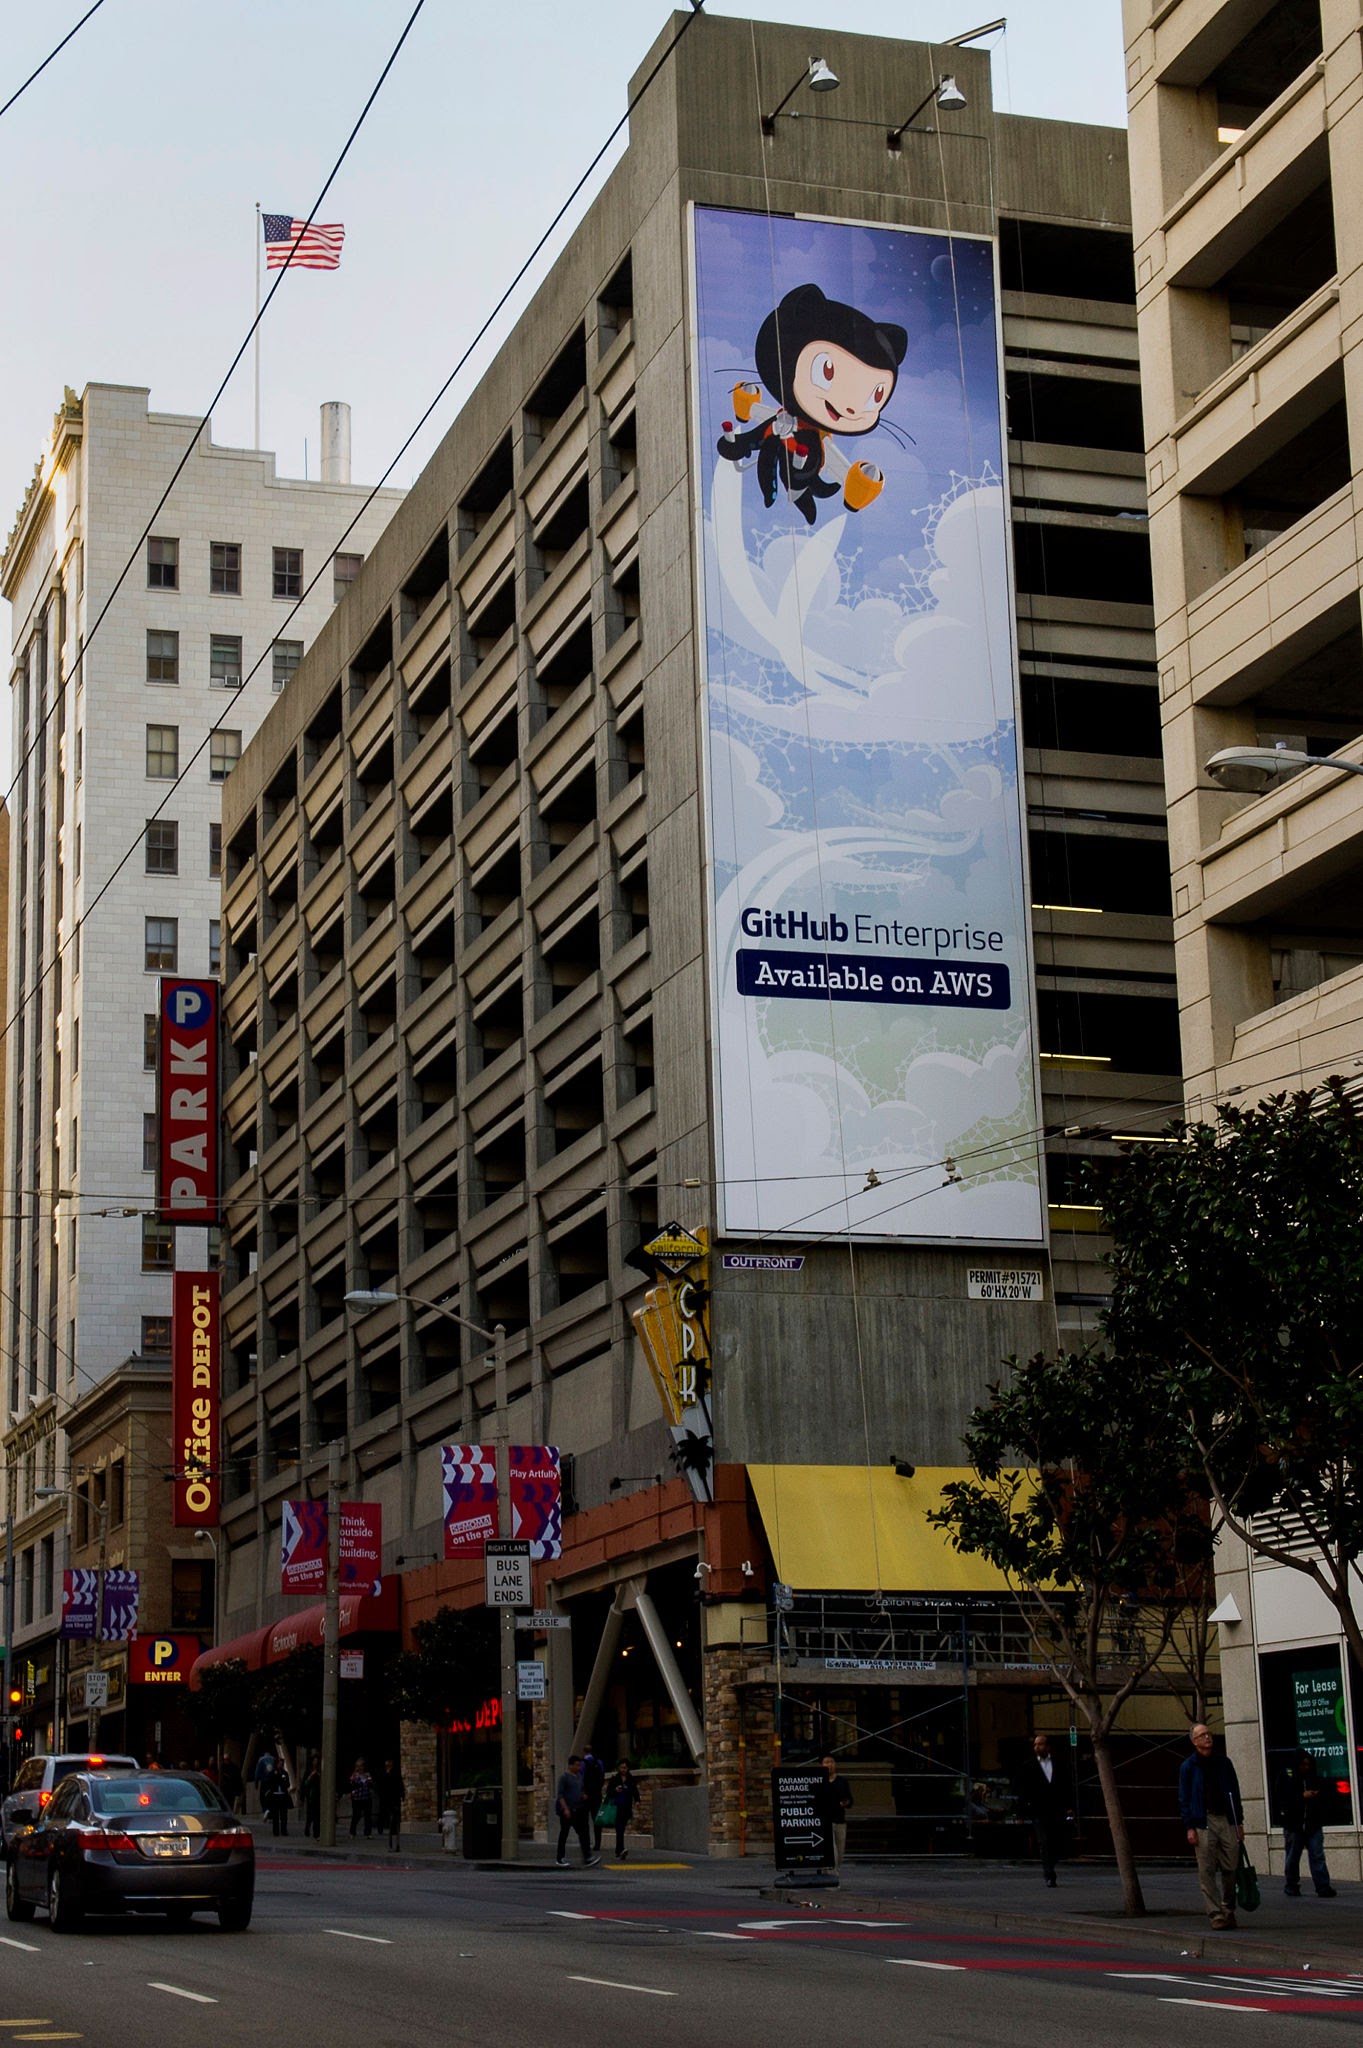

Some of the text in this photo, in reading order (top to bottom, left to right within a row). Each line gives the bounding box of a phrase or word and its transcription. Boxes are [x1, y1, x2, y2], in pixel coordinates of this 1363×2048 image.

[741, 908, 1003, 956] GitHub Enterprise
[755, 962, 992, 997] Available on AWS
[176, 992, 201, 1023] P
[170, 1037, 207, 1209] PARK
[731, 1256, 796, 1269] OUTFRONT
[970, 1271, 1041, 1285] PERMIT#915721
[185, 1285, 211, 1512] Office DEPOT
[510, 1469, 558, 1480] Play Artfully
[341, 1516, 366, 1527] Think
[340, 1528, 373, 1537] outside
[453, 1528, 495, 1545] on the go
[340, 1538, 355, 1547] the
[487, 1544, 507, 1552] RIGHT
[509, 1544, 528, 1552] LANE
[340, 1548, 378, 1560] building.
[497, 1560, 520, 1571] BUS
[289, 1570, 325, 1584] on the go
[494, 1576, 523, 1586] LANE
[495, 1591, 523, 1602] ENDS
[527, 1619, 559, 1627] JESSIE
[154, 1640, 173, 1665] P
[144, 1672, 182, 1682] ENTER
[1295, 1679, 1337, 1695] For Lease
[1313, 1747, 1326, 1758] 772
[1328, 1745, 1344, 1757] 0123
[779, 1777, 823, 1785] PARAMOUNT
[780, 1807, 814, 1816] PUBLIC
[781, 1818, 822, 1828] PARKING
